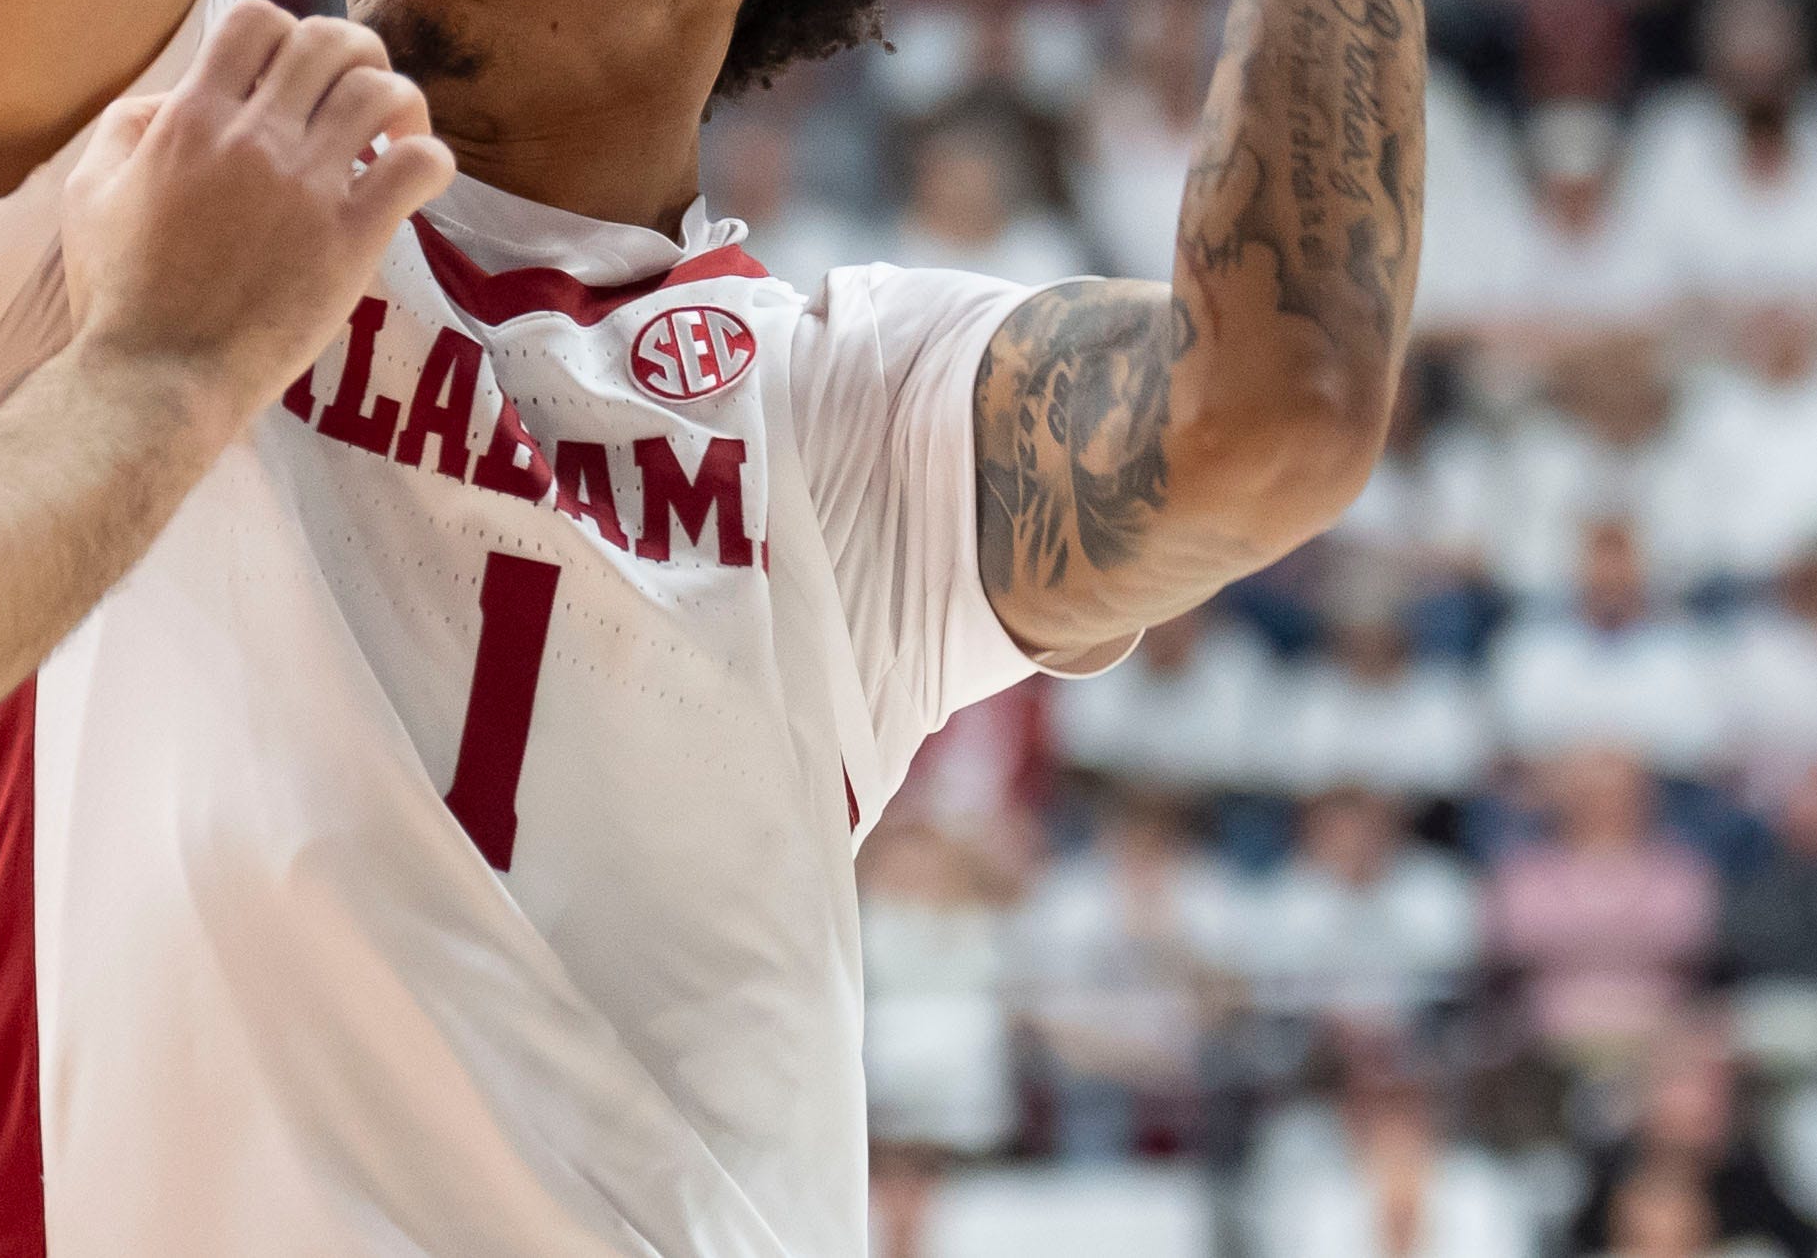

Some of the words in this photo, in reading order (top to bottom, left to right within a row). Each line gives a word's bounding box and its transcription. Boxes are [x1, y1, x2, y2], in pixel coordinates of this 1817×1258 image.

[281, 295, 769, 579] LABAM
[637, 310, 751, 397] SEC
[443, 550, 562, 874] 1
